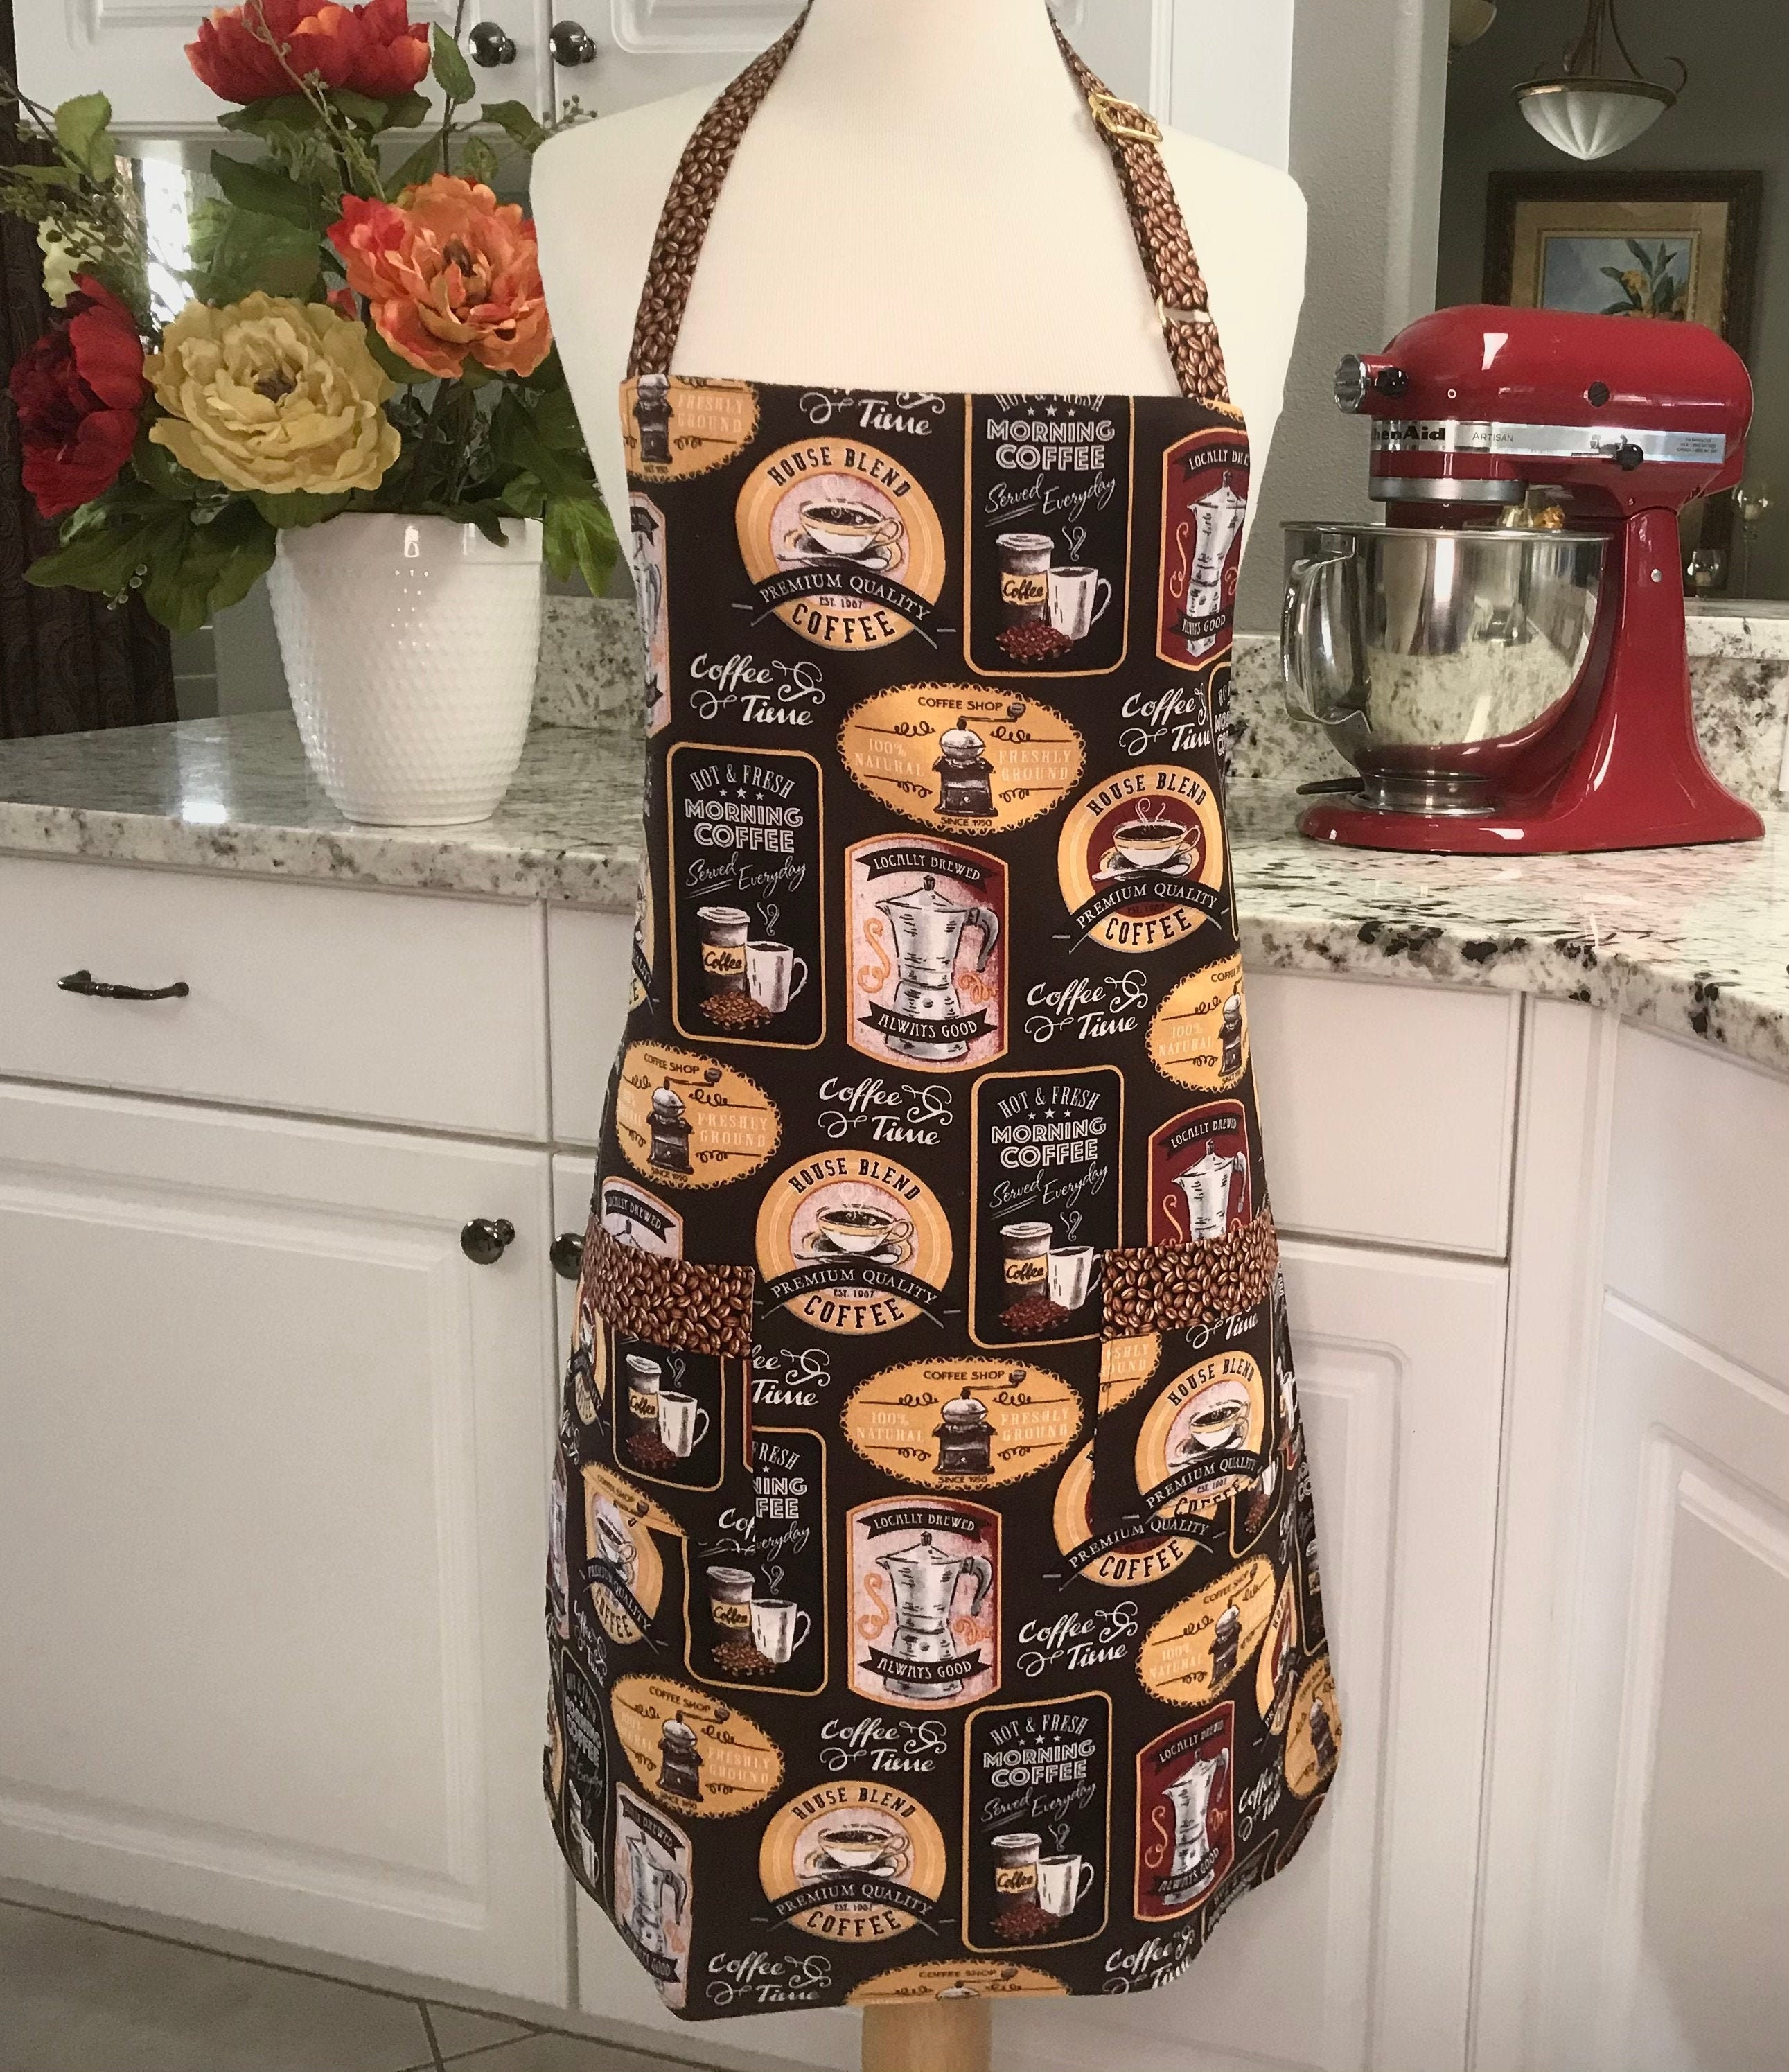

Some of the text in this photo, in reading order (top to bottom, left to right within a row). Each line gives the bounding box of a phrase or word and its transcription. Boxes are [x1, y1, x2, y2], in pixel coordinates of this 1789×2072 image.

[678, 394, 743, 414] FRESHLY
[858, 399, 932, 435] Time
[678, 414, 742, 433] GROUND
[987, 418, 1115, 443] MORNING
[1472, 432, 1513, 441] ARTISAN
[996, 444, 1104, 471] COFFEE
[1189, 449, 1228, 470] LOCALLY
[768, 447, 911, 498] HOUSE BLEND
[985, 471, 1116, 523] Served Everyday
[759, 574, 931, 621] PREMIUM QUALITY
[1003, 581, 1044, 599] Coffee
[792, 604, 895, 644] COFFEE
[1204, 615, 1225, 632] GOOD
[690, 653, 773, 692] Coffee
[741, 695, 814, 726] Time
[917, 696, 1003, 712] COFFEE SHOP
[1122, 687, 1196, 726] Coffee
[867, 738, 907, 757] 100%
[999, 749, 1071, 764] FRESHLY
[854, 752, 924, 778] NATURAL
[1001, 766, 1068, 781] GROUND
[689, 764, 795, 799] HOT & FRESH
[1086, 772, 1207, 816] HOUSE BLEND
[685, 798, 804, 827] MORNING
[940, 817, 969, 826] SINCE
[694, 823, 795, 854] COFFEE
[685, 851, 807, 898] Served Everyday
[873, 854, 980, 881] LOCALLY BREWED
[1076, 882, 1218, 929] PREMIUM QUALITY
[1106, 908, 1192, 946] COFFEE
[705, 951, 742, 970] Coffee
[1026, 977, 1106, 1015] Coffee
[878, 1013, 977, 1039] ALWAYS GOOD
[1077, 1012, 1138, 1039] Time
[1172, 1024, 1202, 1039] 100%
[644, 1053, 700, 1074] COFFEE SHOP
[819, 1076, 902, 1112] Coffee
[997, 1085, 1101, 1120] HOT & FRESH
[698, 1112, 768, 1130] FRESHLY
[872, 1115, 941, 1145] Time
[991, 1116, 1107, 1144] MORNING
[1171, 1121, 1209, 1148] LOCALLY
[700, 1130, 766, 1148] GROUND
[1000, 1138, 1098, 1169] COFFEE
[788, 1157, 920, 1201] HOUSE BLEND
[989, 1161, 1108, 1208] Served Everyday
[1006, 1263, 1046, 1281] Coffee
[770, 1269, 938, 1306] PREMIUM QUALITY
[804, 1294, 905, 1329] COFFEE
[923, 1371, 1005, 1380] COFFEE SHOP
[1167, 1363, 1215, 1406] HOUSE
[1222, 1358, 1255, 1382] BLEND
[629, 1394, 656, 1416] Coffee
[751, 1379, 819, 1405] Time
[872, 1412, 909, 1426] 100%
[1001, 1407, 1069, 1426] FRESHLY
[856, 1428, 924, 1443] NATURAL
[1003, 1423, 1068, 1442] GROUND
[1146, 1461, 1215, 1509] PREMIUM
[874, 1513, 976, 1532] LOCALLY BREWED
[1068, 1525, 1145, 1569] PREMIUM
[1151, 1521, 1209, 1537] QUALITY
[1099, 1538, 1184, 1581] COFFEE
[713, 1605, 747, 1624] Coffee
[1018, 1612, 1095, 1650] Coffee
[877, 1657, 972, 1679] ALWAYS GOOD
[1067, 1641, 1128, 1671] Time
[649, 1686, 711, 1712] COFFEE SHOP
[821, 1717, 901, 1747] Coffee
[990, 1714, 1089, 1746] HOT & FRESH
[708, 1746, 770, 1768] FRESHLY
[870, 1748, 935, 1772] Time
[983, 1739, 1095, 1768] MORNING
[1158, 1735, 1199, 1764] LOCALLY
[709, 1766, 768, 1784] GROUND
[991, 1759, 1087, 1787] COFFEE
[791, 1787, 917, 1820] HOUSE BLEND
[981, 1780, 1097, 1823] Served Everyday
[1199, 1847, 1220, 1875] GOOD
[998, 1872, 1034, 1889] Coffee
[776, 1884, 933, 1916] PREMIUM QUALITY
[807, 1911, 901, 1938] COFFEE
[708, 1951, 786, 1983] Coffee
[1104, 1935, 1174, 1974] Coffee
[756, 1984, 821, 2003] Time
